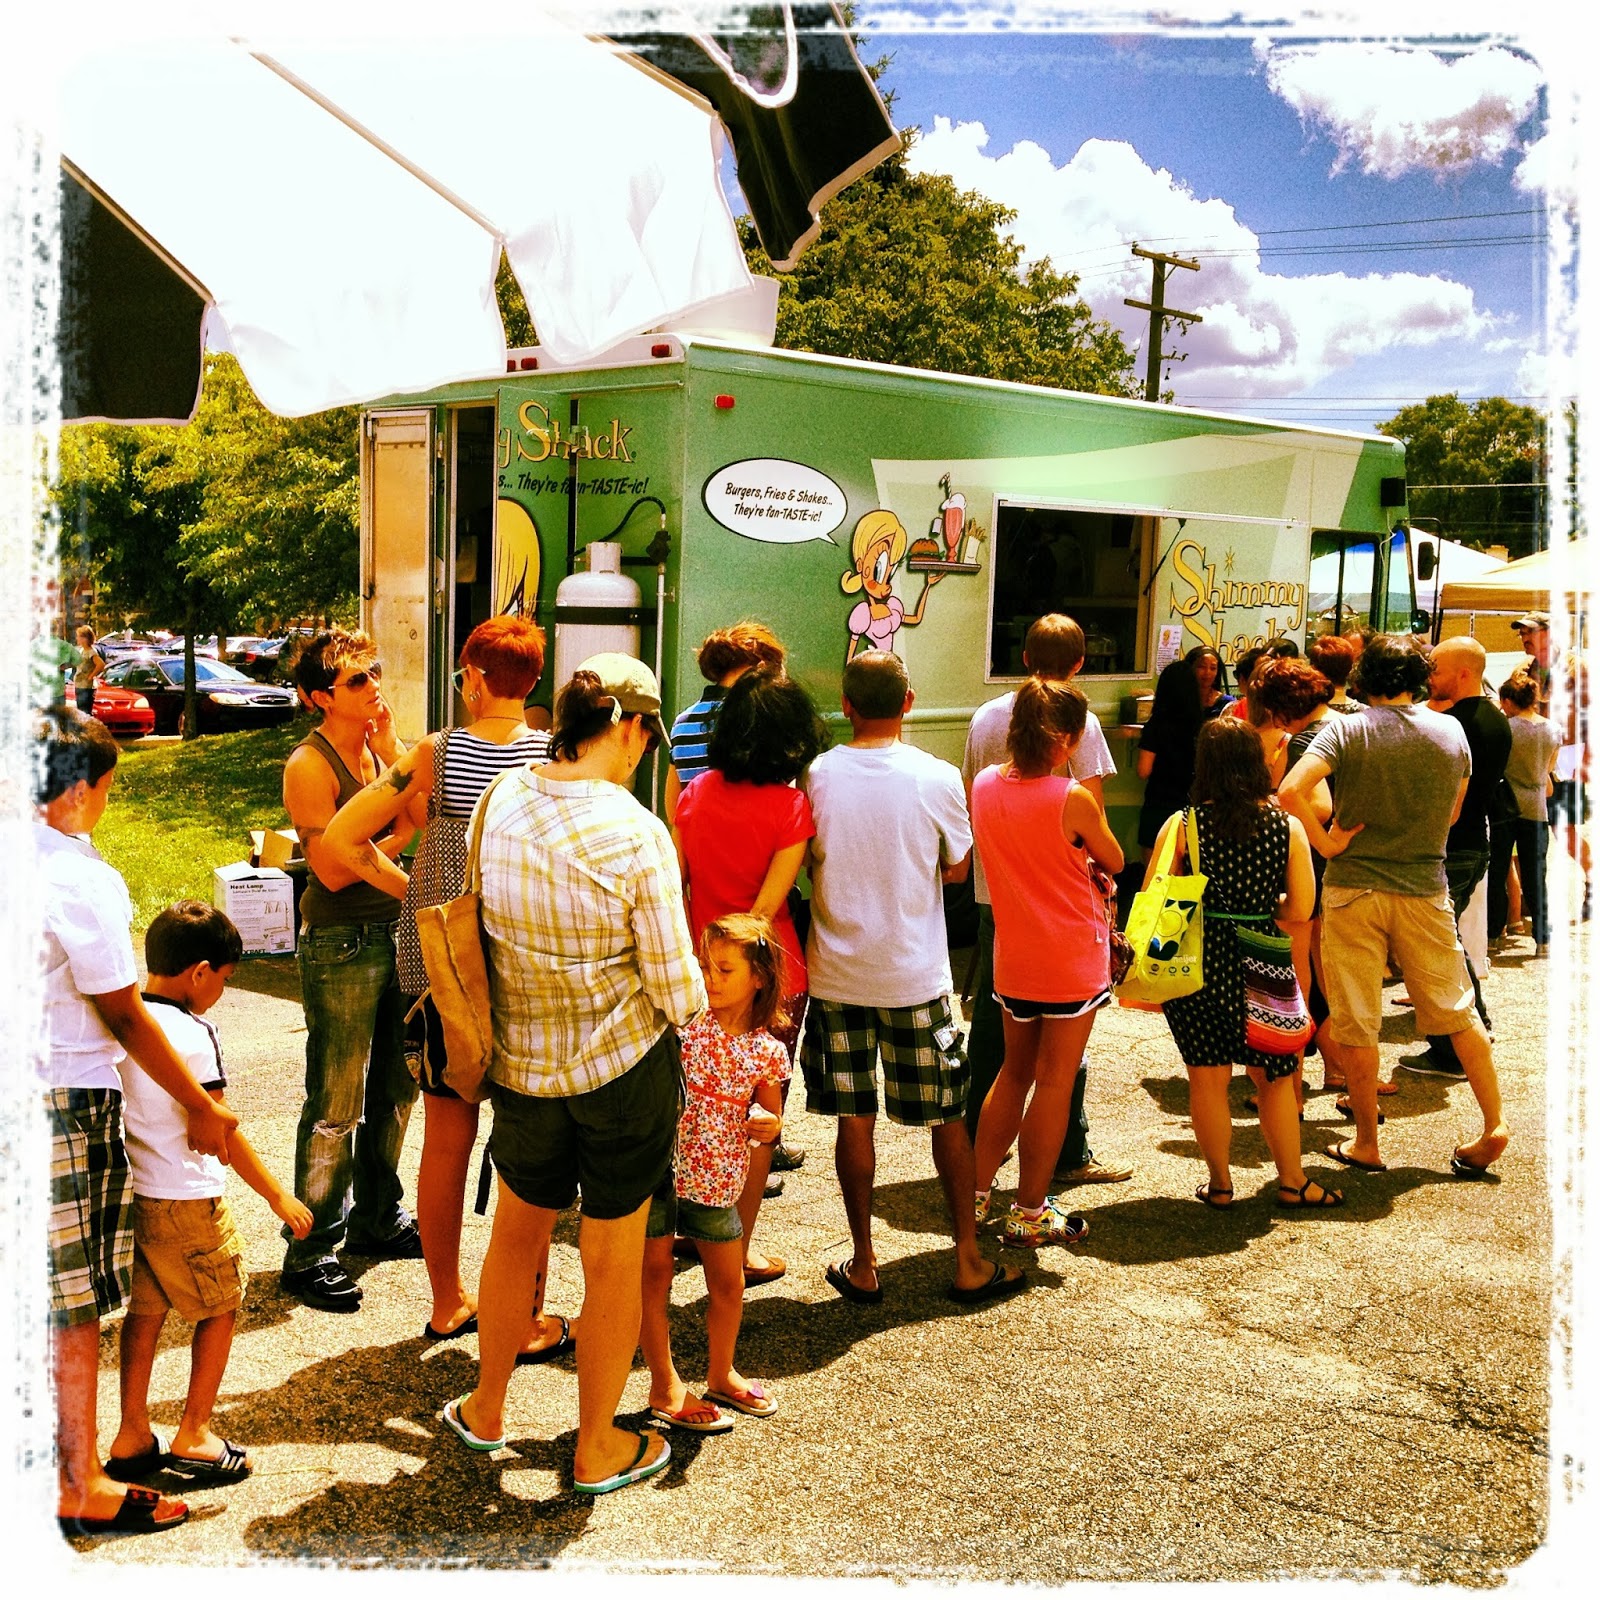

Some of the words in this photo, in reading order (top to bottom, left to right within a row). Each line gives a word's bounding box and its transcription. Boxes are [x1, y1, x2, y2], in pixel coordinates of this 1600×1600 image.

[517, 400, 635, 463] Shack
[518, 472, 558, 496] They're
[725, 482, 762, 500] Burgers,
[764, 486, 786, 500] Fries
[787, 489, 796, 501] &
[734, 502, 763, 519] They're
[766, 505, 822, 522] fan-TASTE-ic!
[1170, 539, 1305, 631] Shimmy
